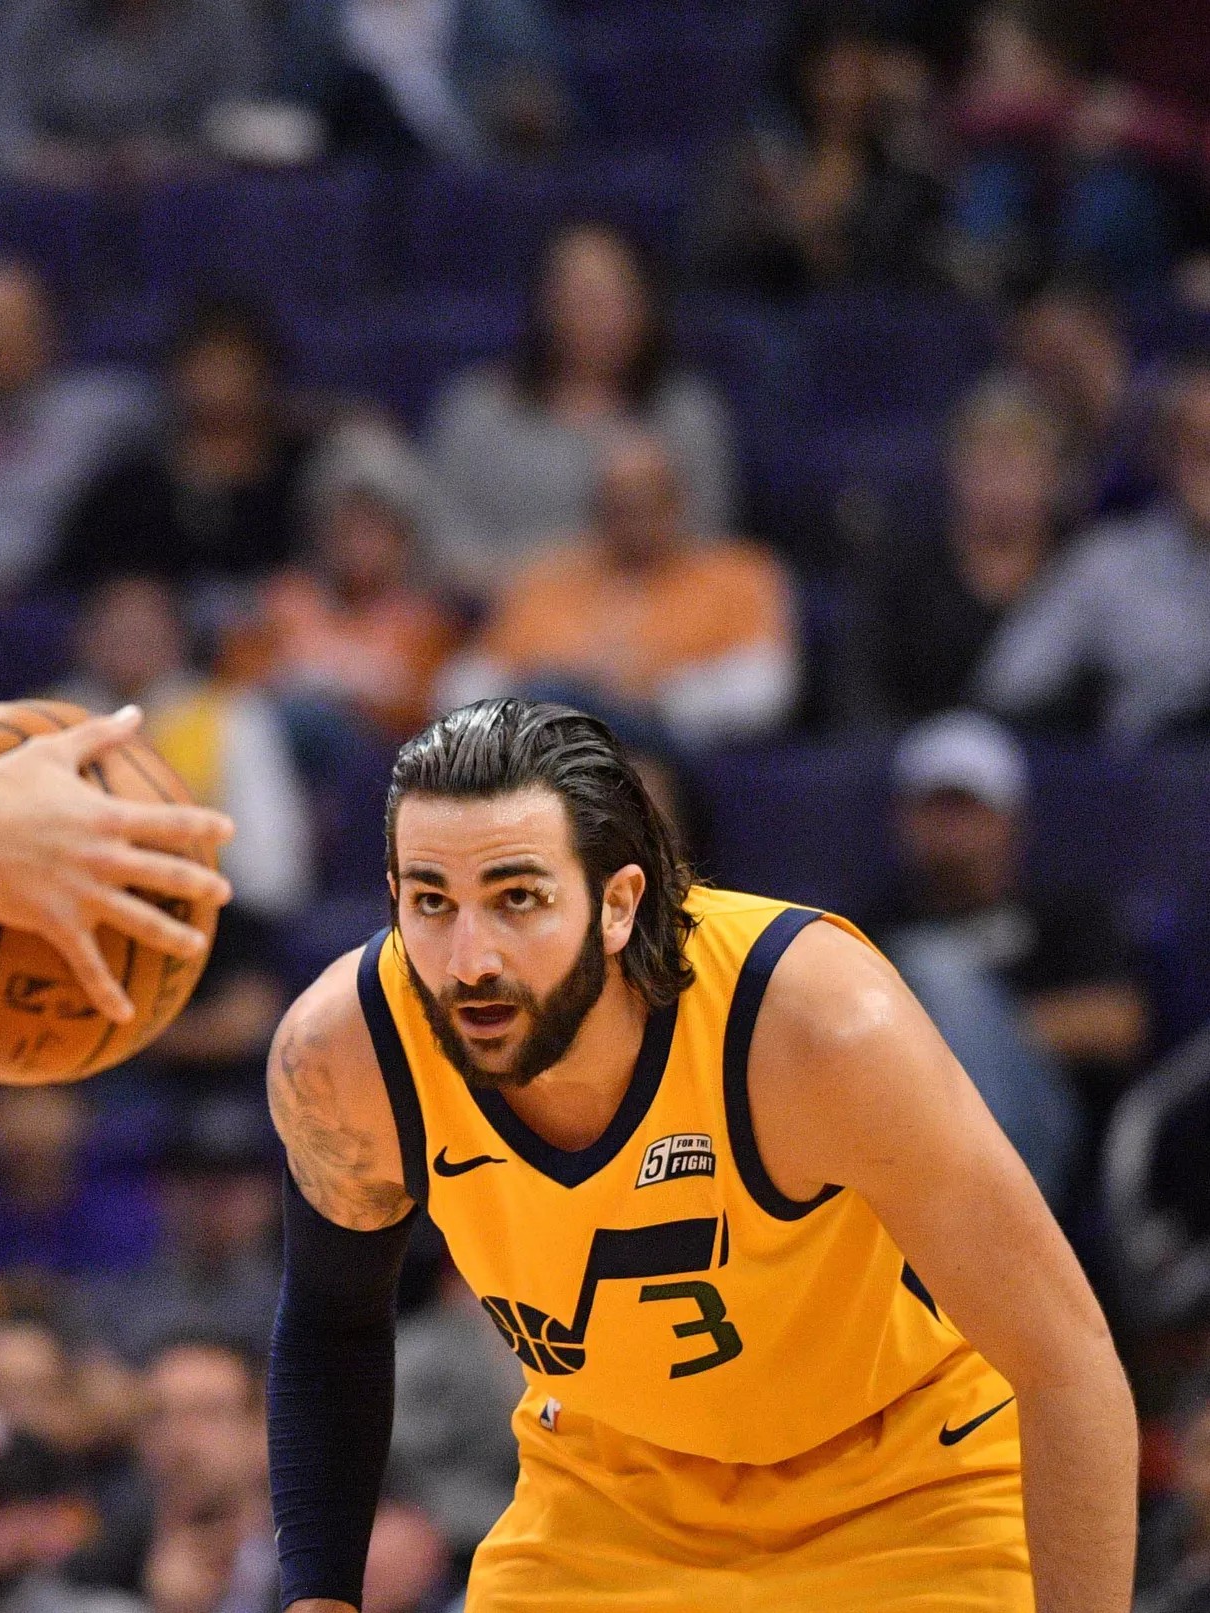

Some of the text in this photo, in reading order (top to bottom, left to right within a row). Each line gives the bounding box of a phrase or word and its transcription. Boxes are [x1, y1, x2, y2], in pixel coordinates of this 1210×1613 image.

[676, 1138, 709, 1149] FOR THE
[645, 1143, 665, 1179] 5
[671, 1155, 713, 1173] FIGHT
[639, 1280, 743, 1379] 3
